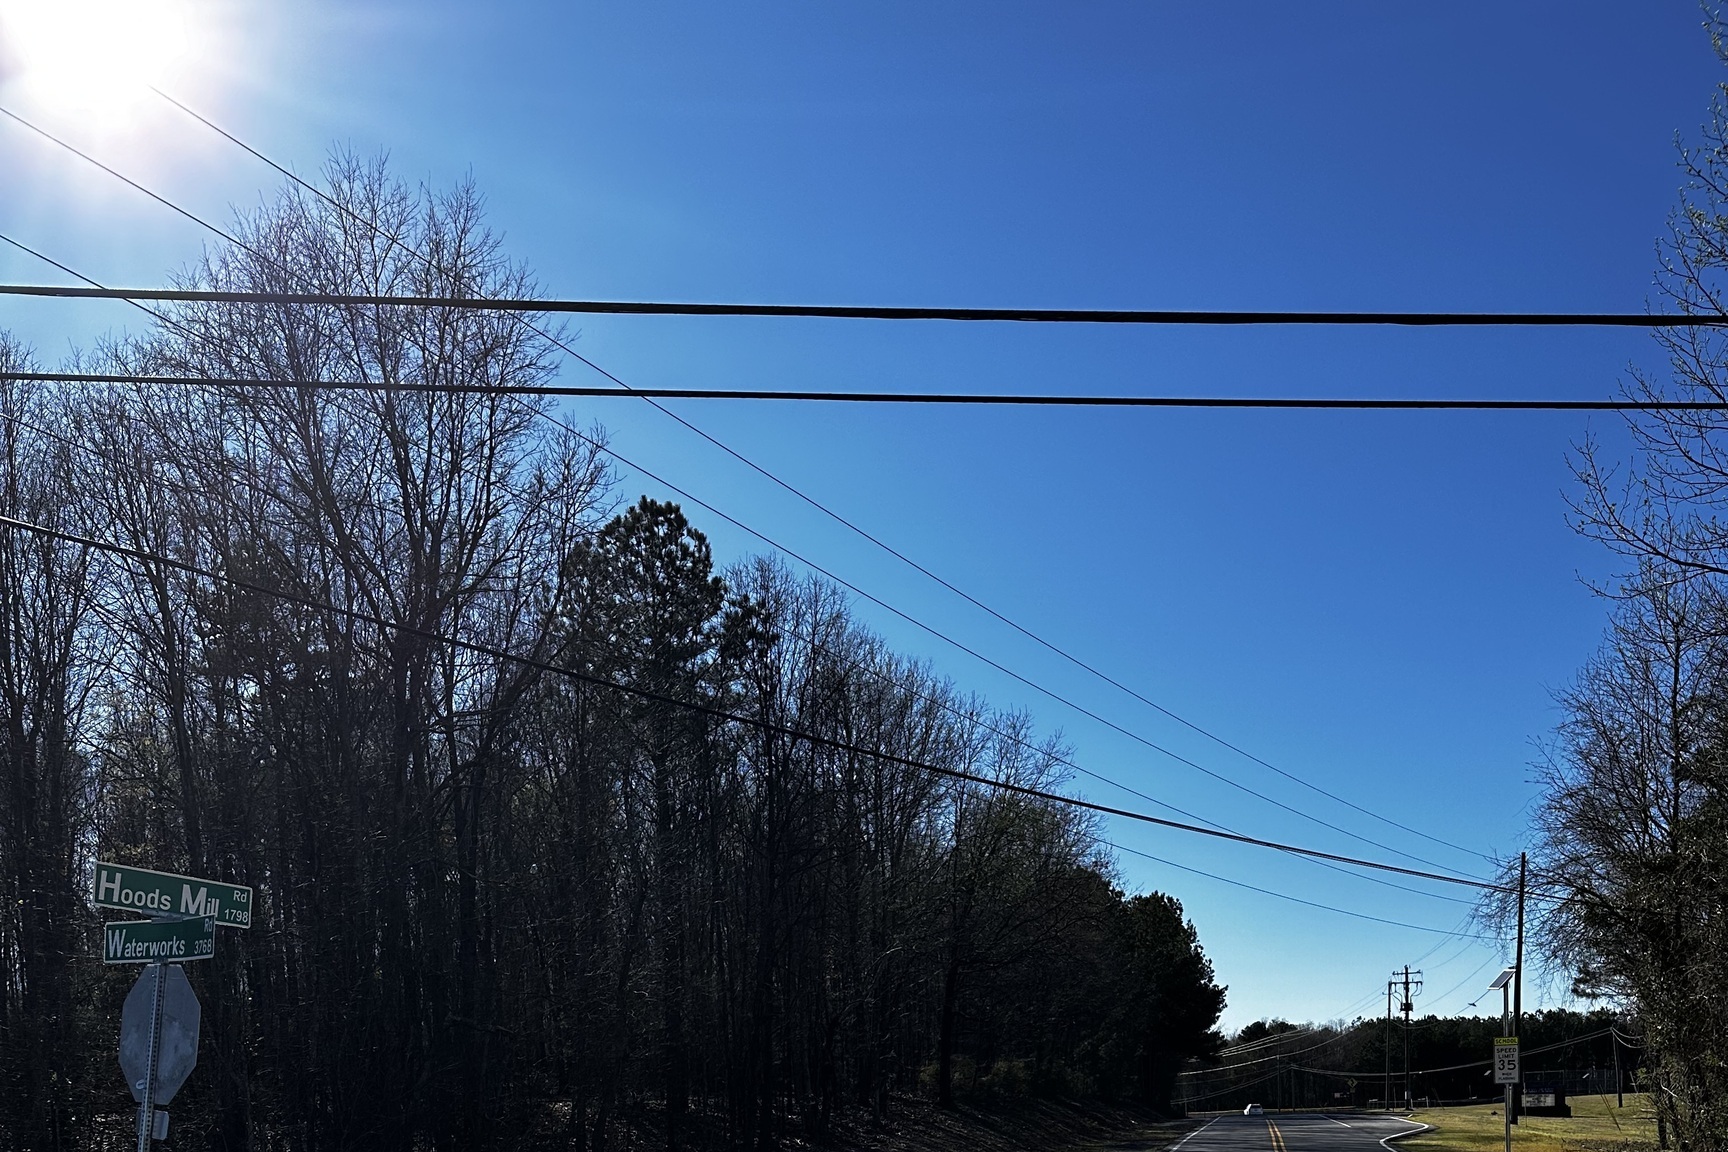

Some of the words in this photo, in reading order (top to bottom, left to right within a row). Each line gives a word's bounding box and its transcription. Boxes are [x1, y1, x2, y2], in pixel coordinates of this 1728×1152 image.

[99, 871, 172, 910] Hoods
[180, 884, 219, 917] Mill
[233, 890, 248, 903] Rd
[224, 908, 249, 923] 1798
[108, 929, 185, 958] Waterworks
[204, 919, 213, 932] Rd
[194, 938, 213, 955] 3768
[1498, 1060, 1516, 1070] 35
